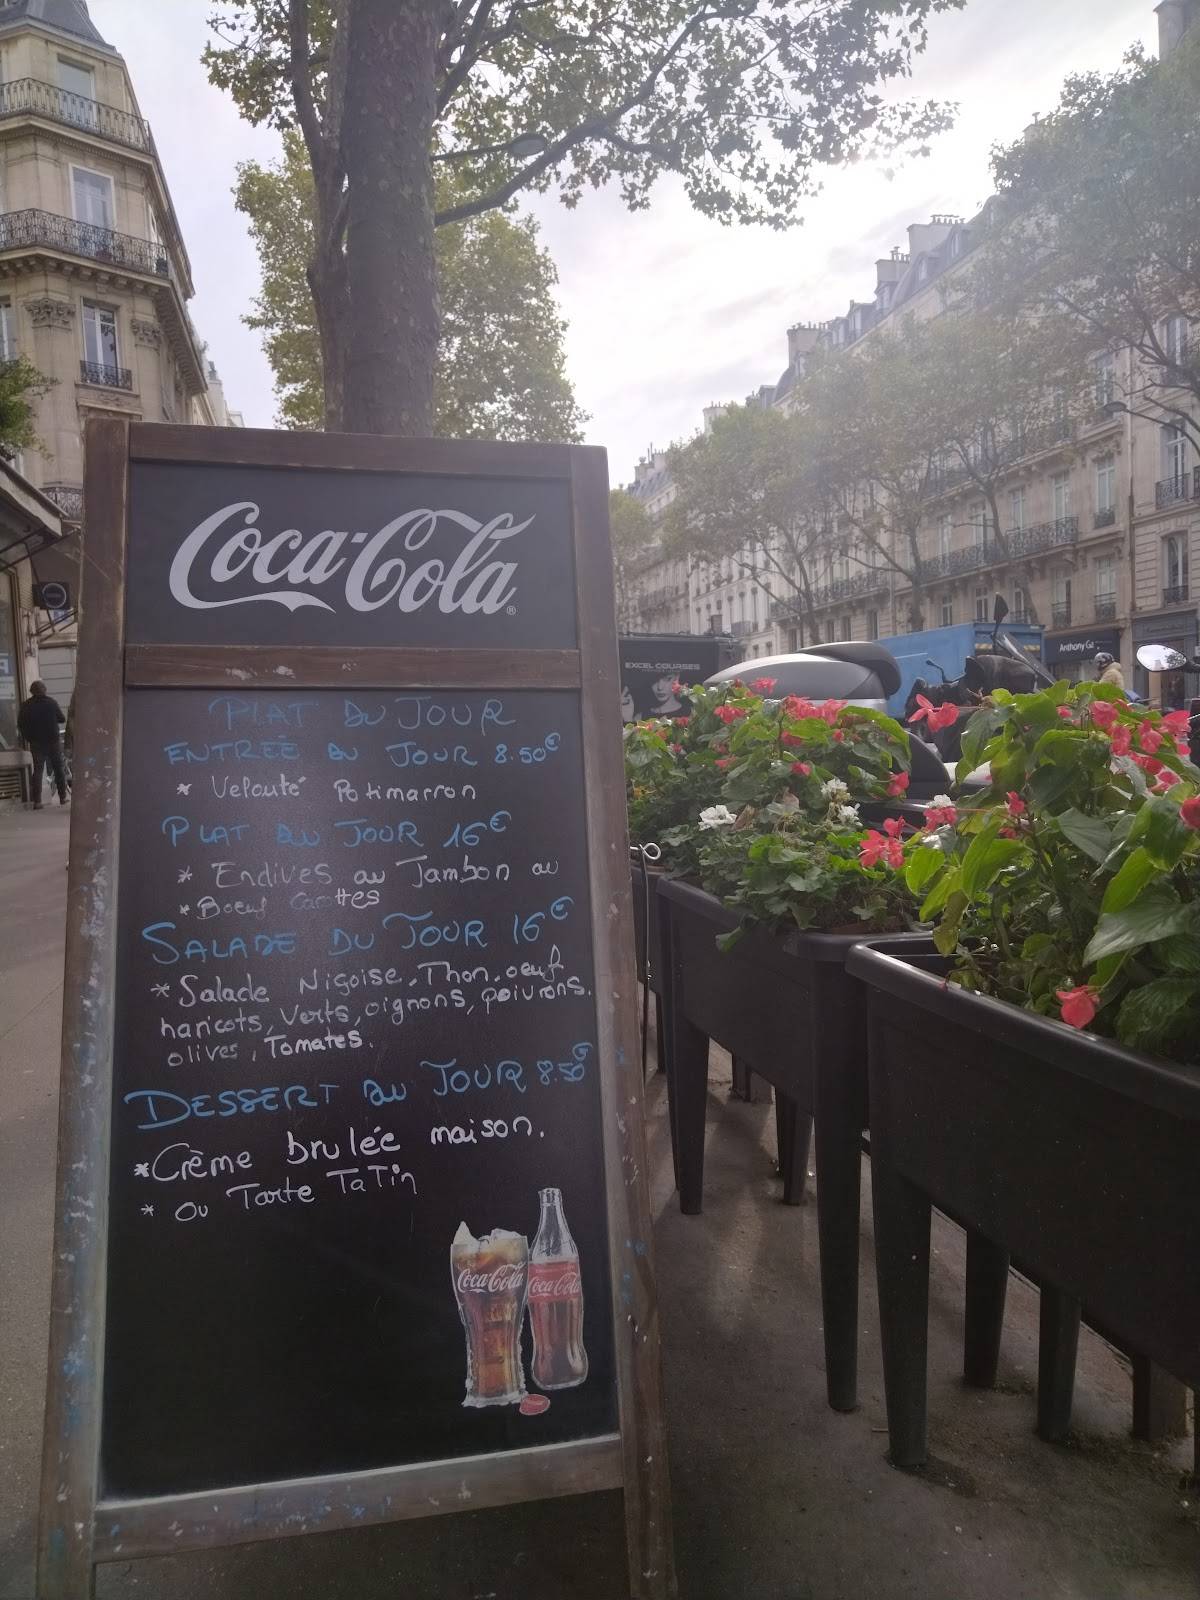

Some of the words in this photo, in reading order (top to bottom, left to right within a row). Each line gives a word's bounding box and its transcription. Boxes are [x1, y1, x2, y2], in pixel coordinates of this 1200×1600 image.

[169, 501, 536, 615] Coca-Cola
[655, 662, 700, 670] COURSES
[395, 696, 516, 736] JOUR
[386, 741, 478, 768] JOUR
[335, 818, 424, 848] JOUR
[211, 861, 332, 888] Endives
[382, 910, 488, 950] JOUR
[179, 974, 270, 1008] Salade
[419, 1058, 527, 1097] JOUR
[457, 1262, 528, 1294] Coca-Cola
